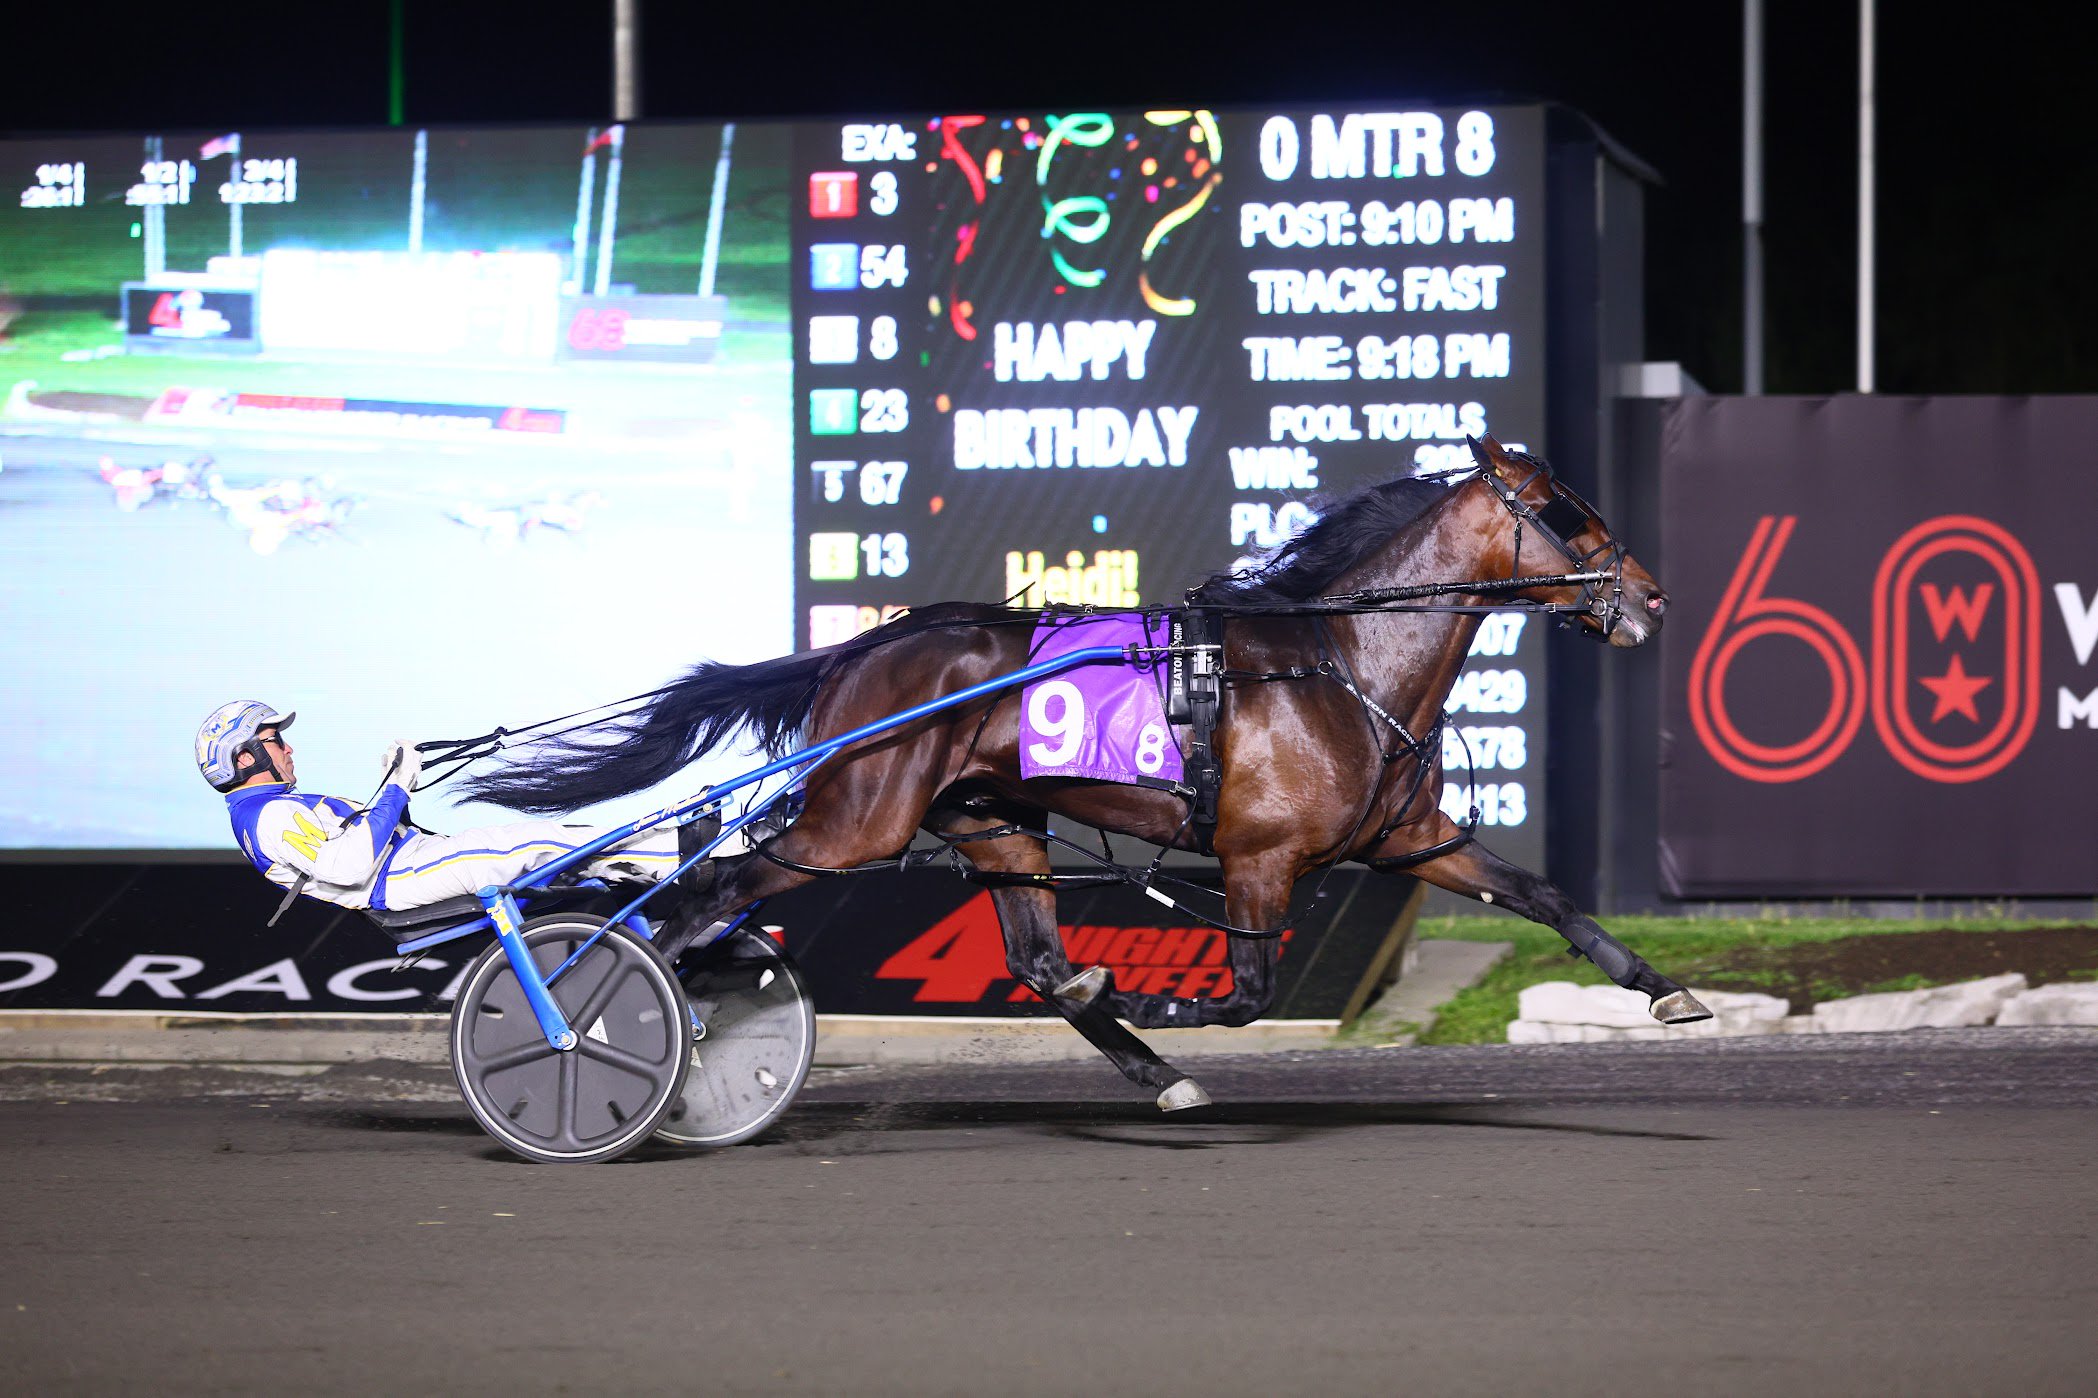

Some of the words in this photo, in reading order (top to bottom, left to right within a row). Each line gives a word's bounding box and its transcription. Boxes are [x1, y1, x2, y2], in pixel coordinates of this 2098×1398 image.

[842, 124, 917, 162] EXA:
[1260, 115, 1299, 181] 0
[1311, 112, 1445, 179] MTR
[1455, 110, 1496, 176] 8
[870, 171, 899, 217] 3
[1241, 201, 1356, 248] POST:
[1361, 199, 1444, 246] 9:10
[1449, 197, 1514, 243] PM
[860, 244, 909, 289] 54
[1248, 268, 1397, 315] TRACK:
[1403, 265, 1506, 312] FAST
[870, 316, 898, 361] 8
[994, 320, 1157, 382] HAPPY
[1242, 336, 1352, 381] TIME:
[1356, 334, 1440, 379] 9:18
[1444, 333, 1510, 378] PM
[860, 388, 909, 433] 23
[1269, 404, 1362, 442] POOL
[1362, 401, 1487, 441] TOTALS
[954, 406, 1199, 470] BIRTHDAY
[860, 461, 909, 506] 67
[1228, 446, 1319, 489] WIN:
[860, 533, 909, 578] 13
[1006, 549, 1140, 608] Heidi!
[1467, 612, 1527, 656] 07
[1688, 514, 2042, 784] 60
[1028, 680, 1085, 767] 9
[1388, 717, 1417, 746] RACIN
[1135, 724, 1166, 774] 8
[282, 811, 329, 863] M
[1055, 924, 1295, 965] NIGHT
